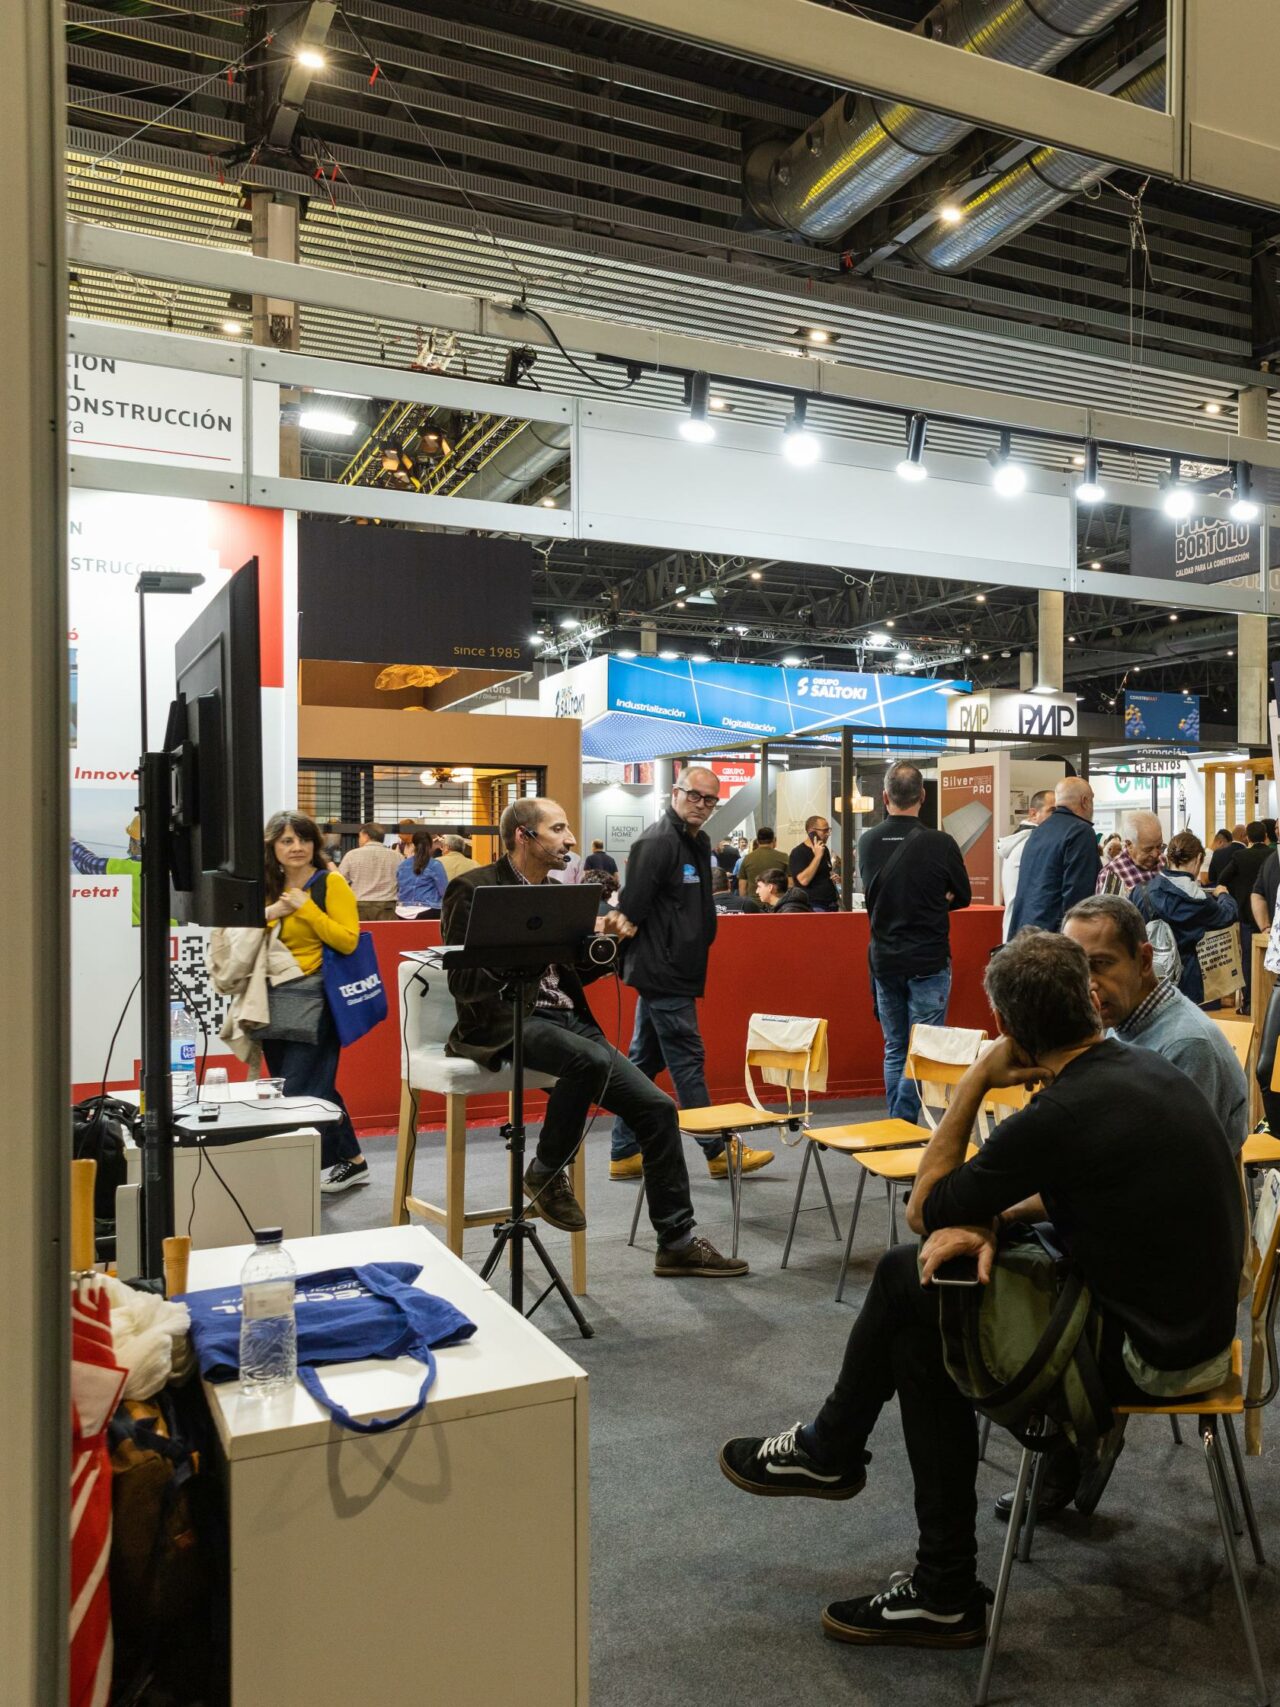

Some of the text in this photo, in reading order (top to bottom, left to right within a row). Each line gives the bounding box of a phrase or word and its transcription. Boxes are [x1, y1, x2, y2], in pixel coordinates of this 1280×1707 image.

[1175, 523, 1250, 563] BORTOLO
[1175, 567, 1194, 577] CALIDAD
[1194, 564, 1206, 573] PARA
[1213, 552, 1250, 568] CONSTRUCCIÓN
[453, 645, 521, 659] since 1985
[812, 677, 840, 686] GRUPO
[810, 685, 868, 700] SALTOKI
[616, 698, 686, 719] Industrialización
[721, 717, 777, 733] Digitalización
[1134, 760, 1181, 773] CEMENTOS
[942, 776, 974, 787] Silver
[972, 784, 992, 795] PRO
